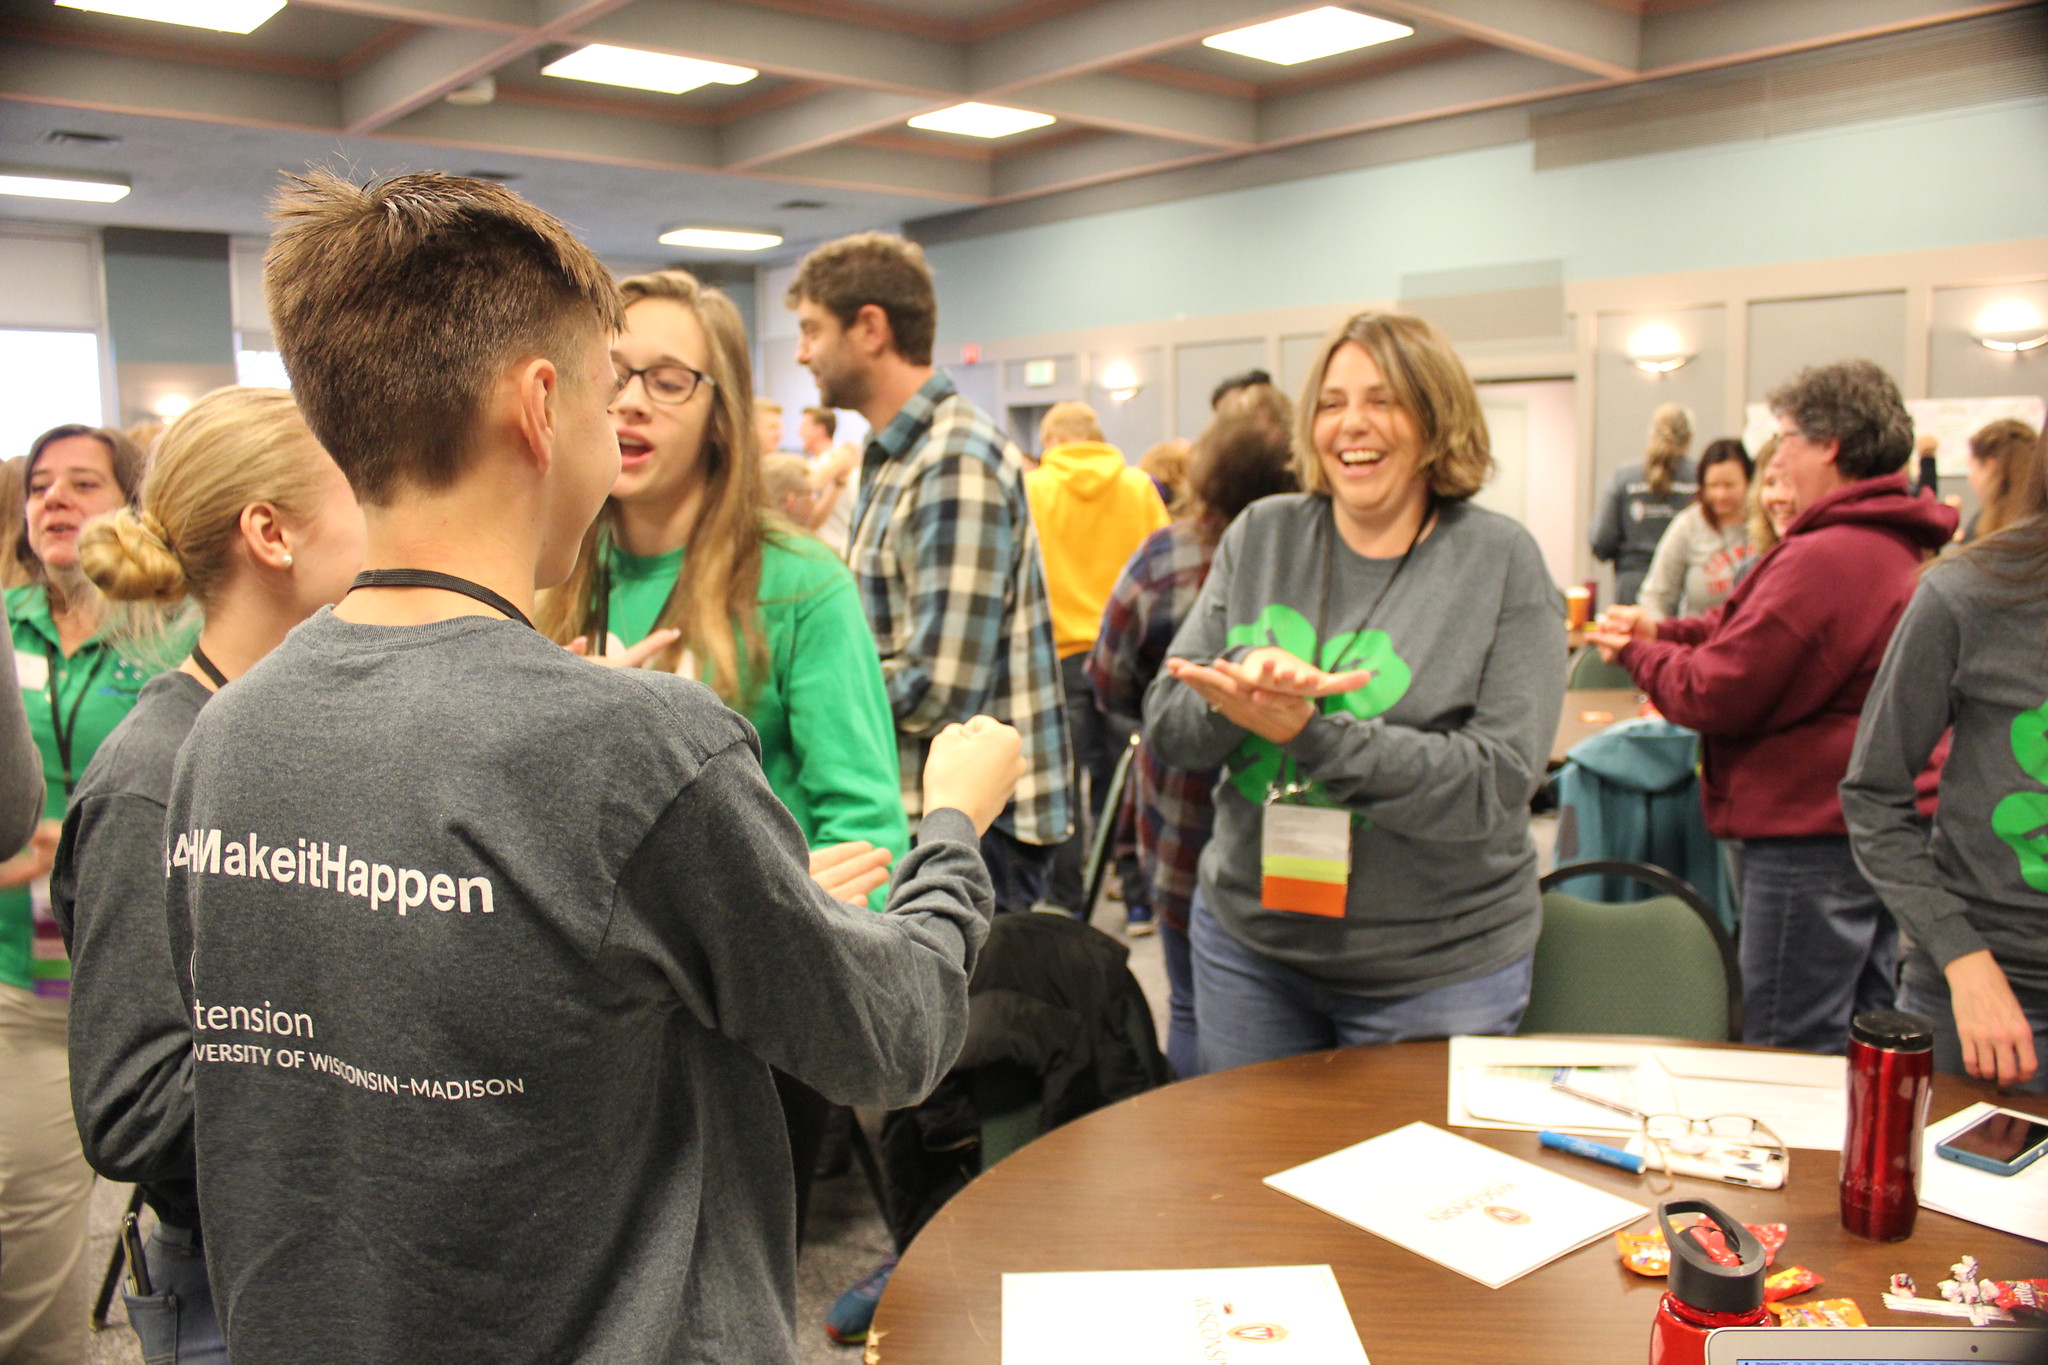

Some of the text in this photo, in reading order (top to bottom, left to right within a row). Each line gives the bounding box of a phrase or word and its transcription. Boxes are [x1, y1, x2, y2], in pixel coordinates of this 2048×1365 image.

[166, 828, 495, 916] 4HMakeitHappen
[193, 998, 314, 1039] tension
[193, 1042, 272, 1066] VERSITY
[276, 1049, 305, 1069] OF
